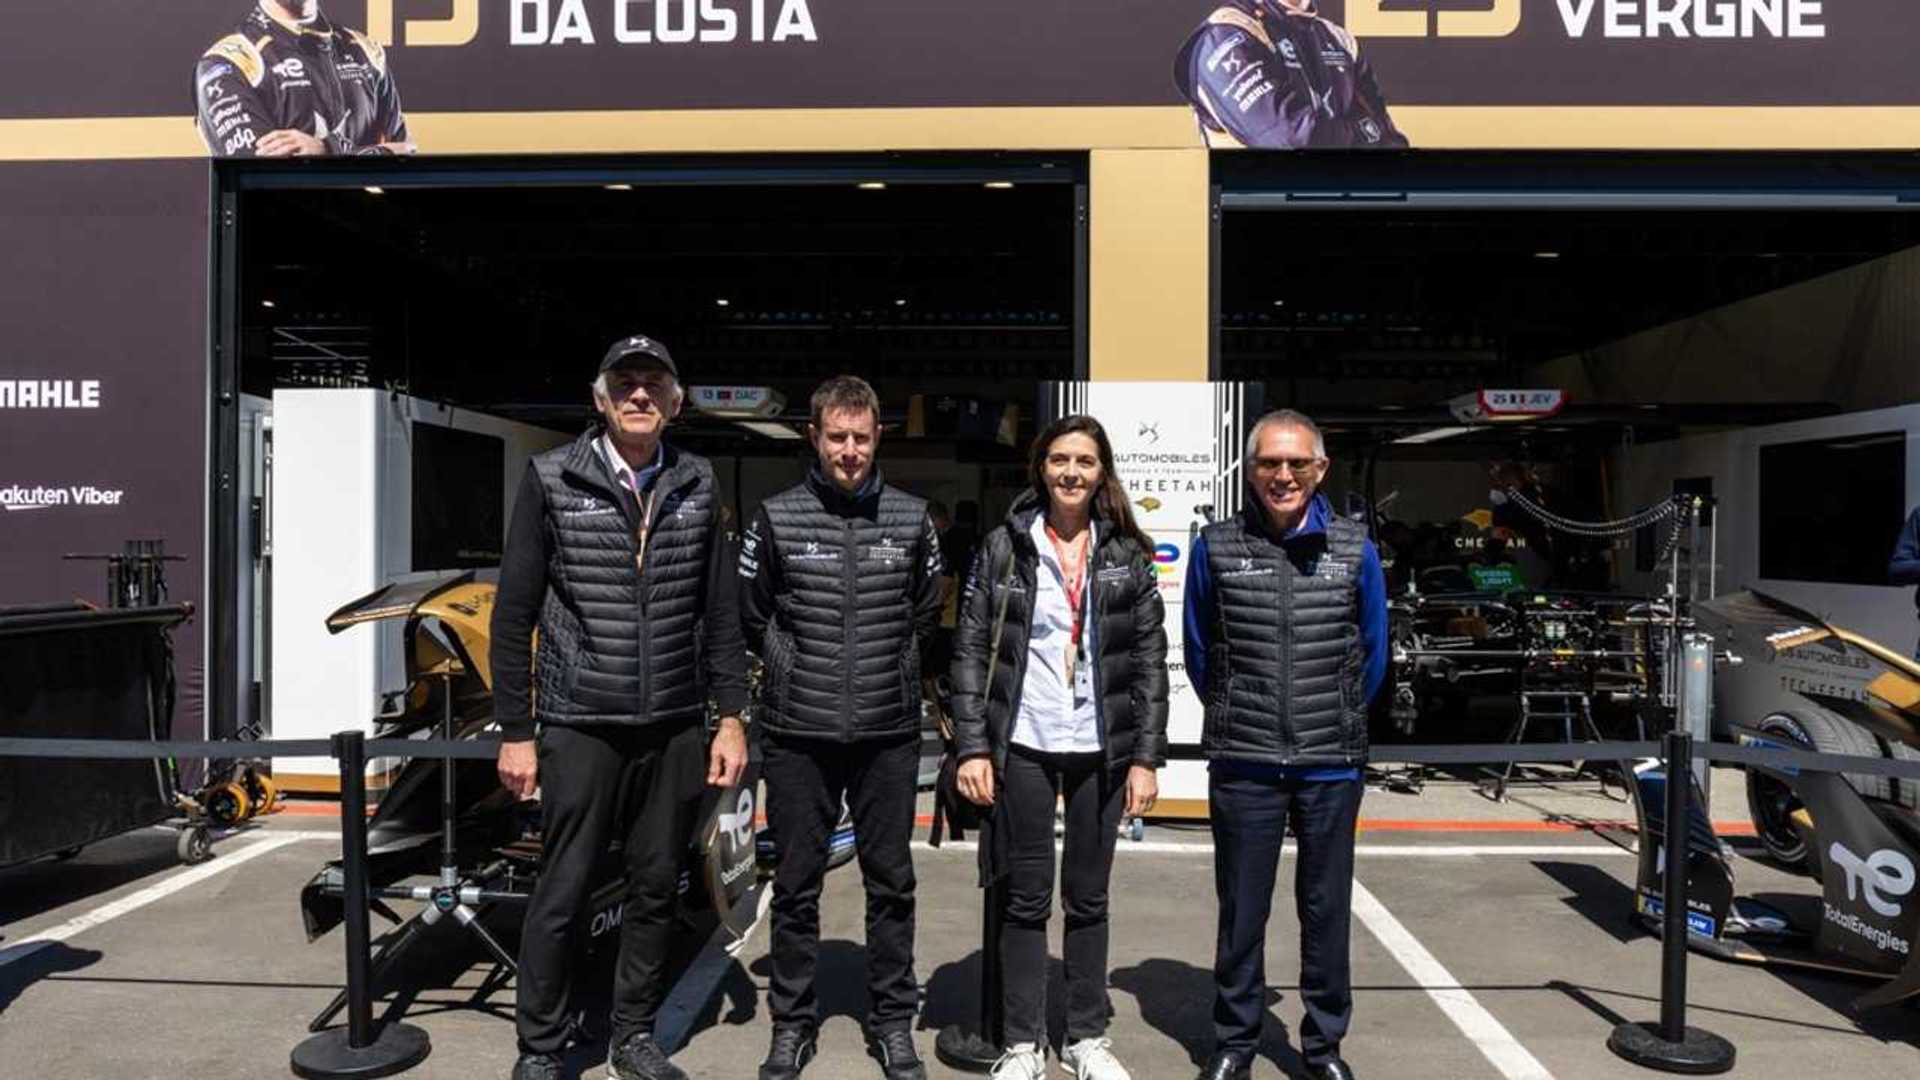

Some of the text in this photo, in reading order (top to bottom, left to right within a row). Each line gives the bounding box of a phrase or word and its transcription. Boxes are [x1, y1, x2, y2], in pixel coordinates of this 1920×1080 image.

[510, 0, 596, 45] DA
[614, 0, 818, 43] COSTA
[1555, 0, 1826, 38] VERGNE
[0, 484, 123, 505] akuten Viber
[1121, 479, 1211, 492] HEETAH
[1823, 902, 1910, 955] TotalEnergies
